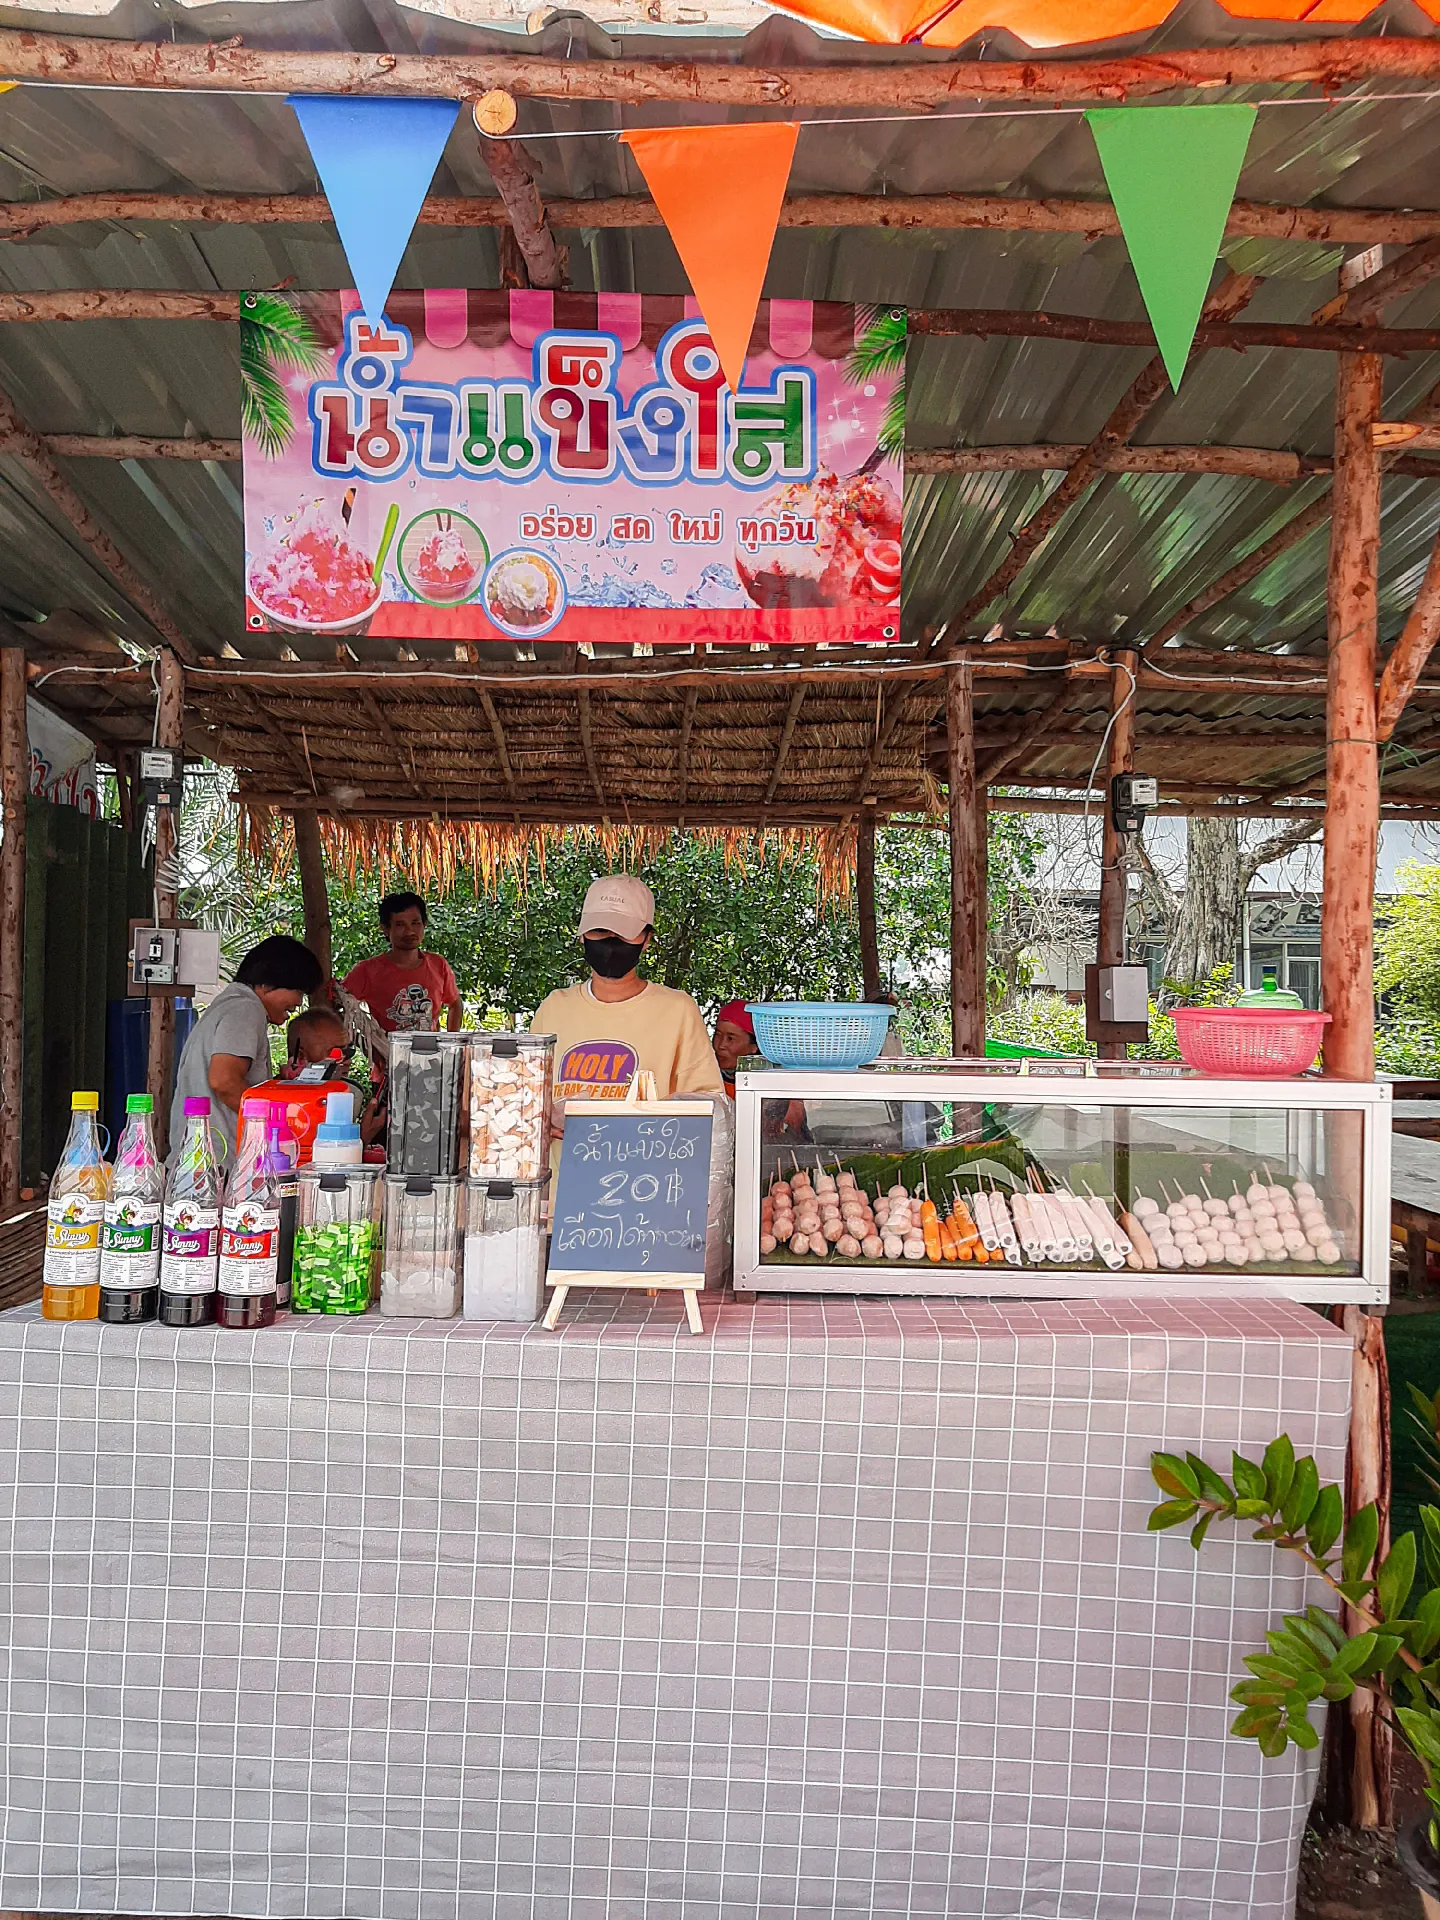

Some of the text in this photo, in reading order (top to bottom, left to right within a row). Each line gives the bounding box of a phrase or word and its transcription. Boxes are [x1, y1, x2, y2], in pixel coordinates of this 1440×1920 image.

[312, 316, 811, 484] น้ำแข็งใส
[521, 505, 817, 552] อร่อย สด ใหม่ ทุกวัน
[564, 1052, 629, 1080] HOLY
[572, 1118, 700, 1162] น้ำแข็งใส
[109, 1231, 145, 1247] Sunny
[167, 1235, 201, 1251] Sunny
[230, 1238, 264, 1253] Sunny
